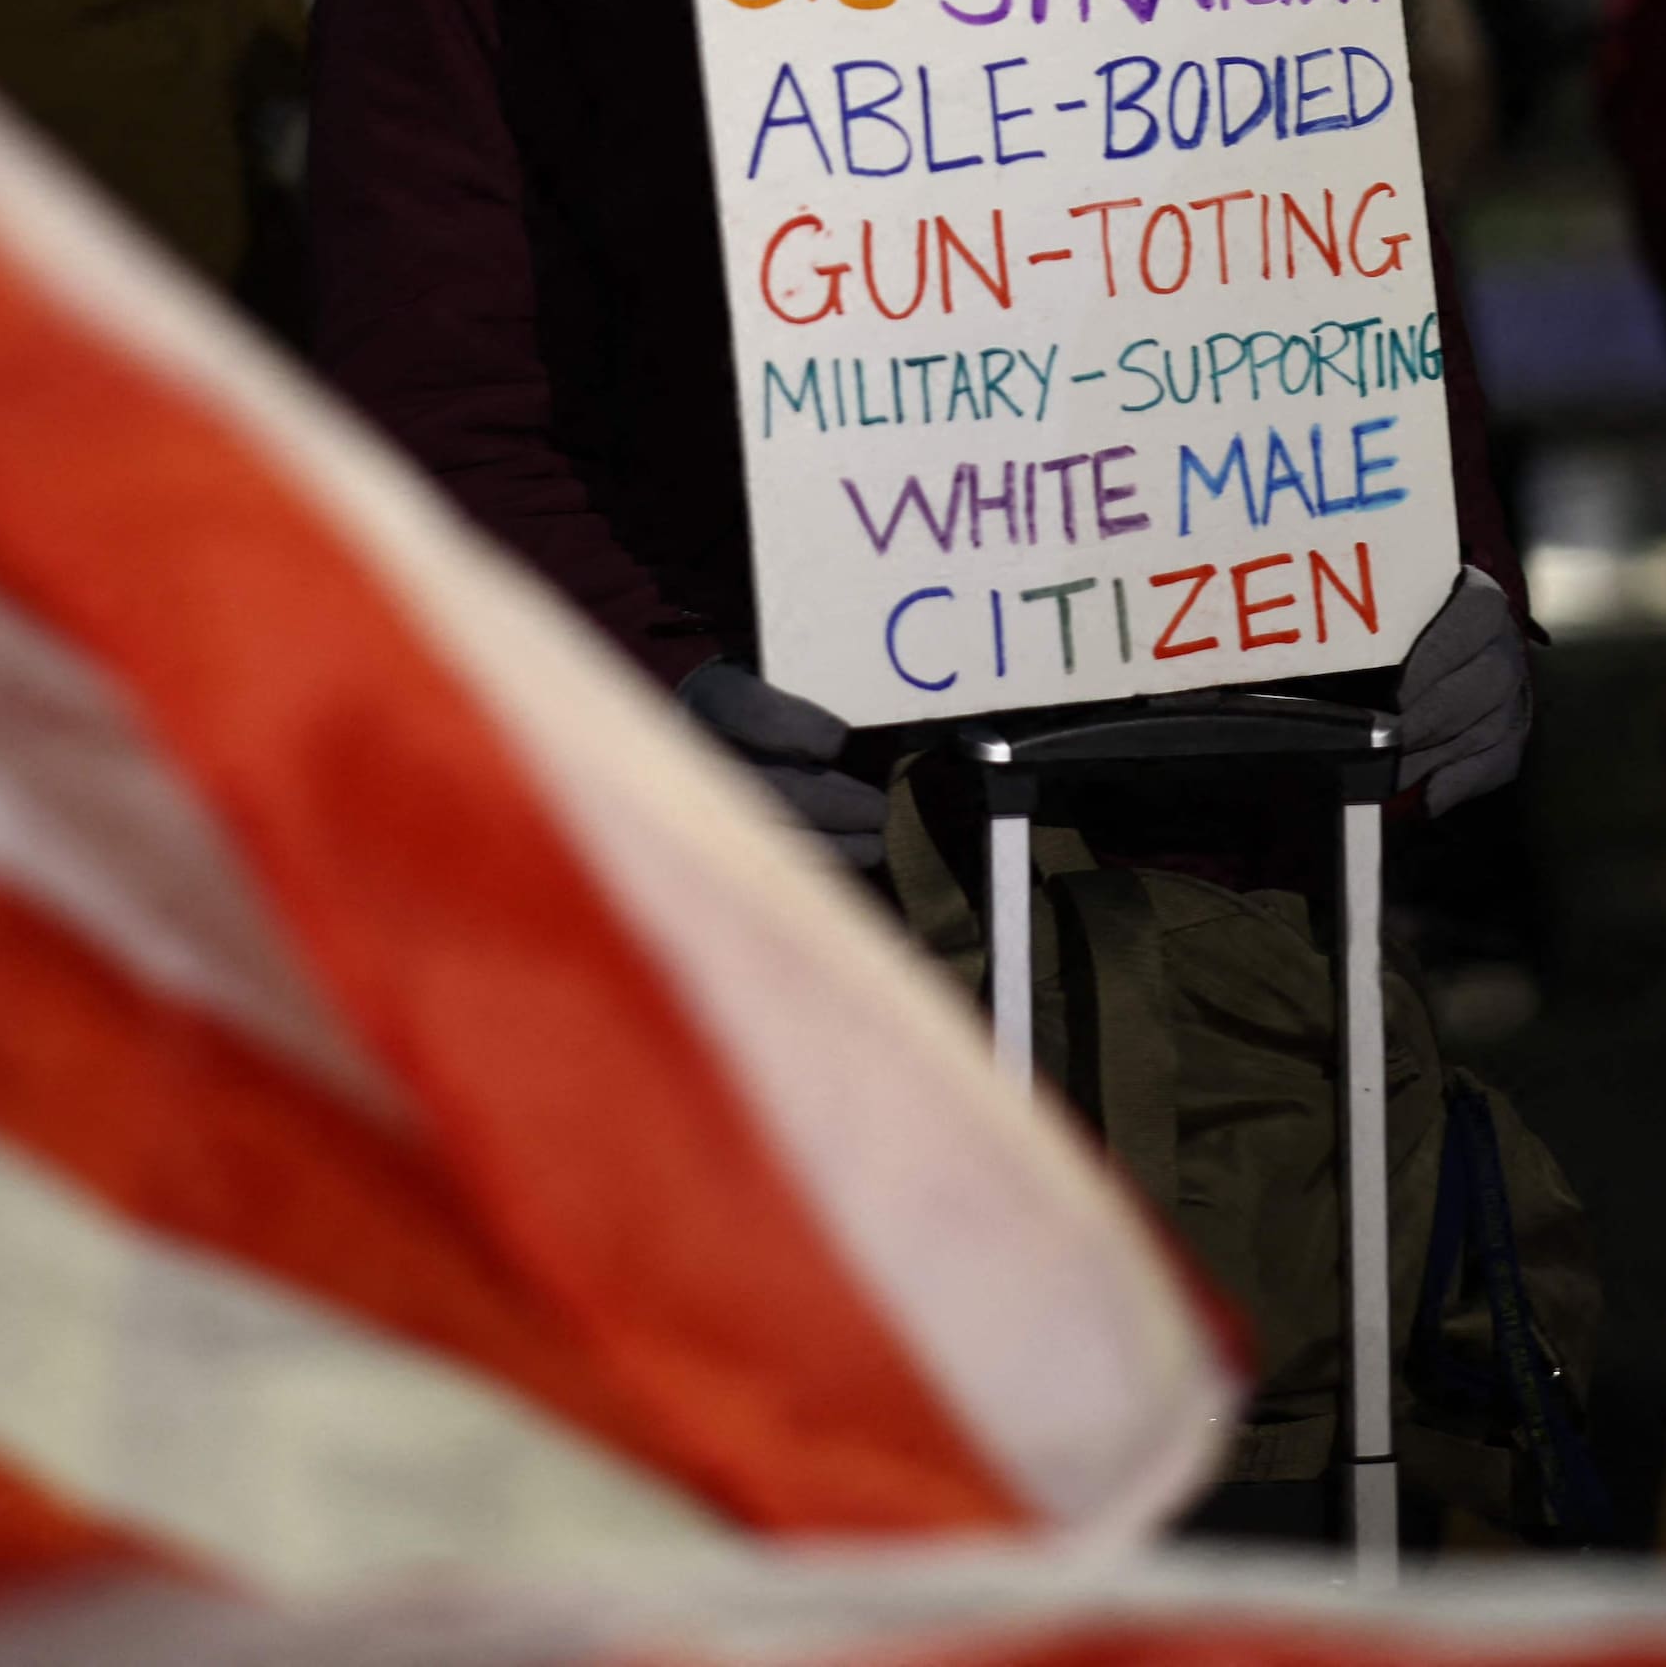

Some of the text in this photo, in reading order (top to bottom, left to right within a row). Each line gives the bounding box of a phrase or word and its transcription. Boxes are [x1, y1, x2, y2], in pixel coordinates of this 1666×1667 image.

[747, 46, 1394, 179] ABLE-BODIED
[760, 181, 1411, 326] GUN-TOTING
[764, 312, 1445, 439] MILITARY-SUPPORTING
[842, 417, 1408, 555] WHITE MALE
[885, 542, 1379, 692] CITIZEN
